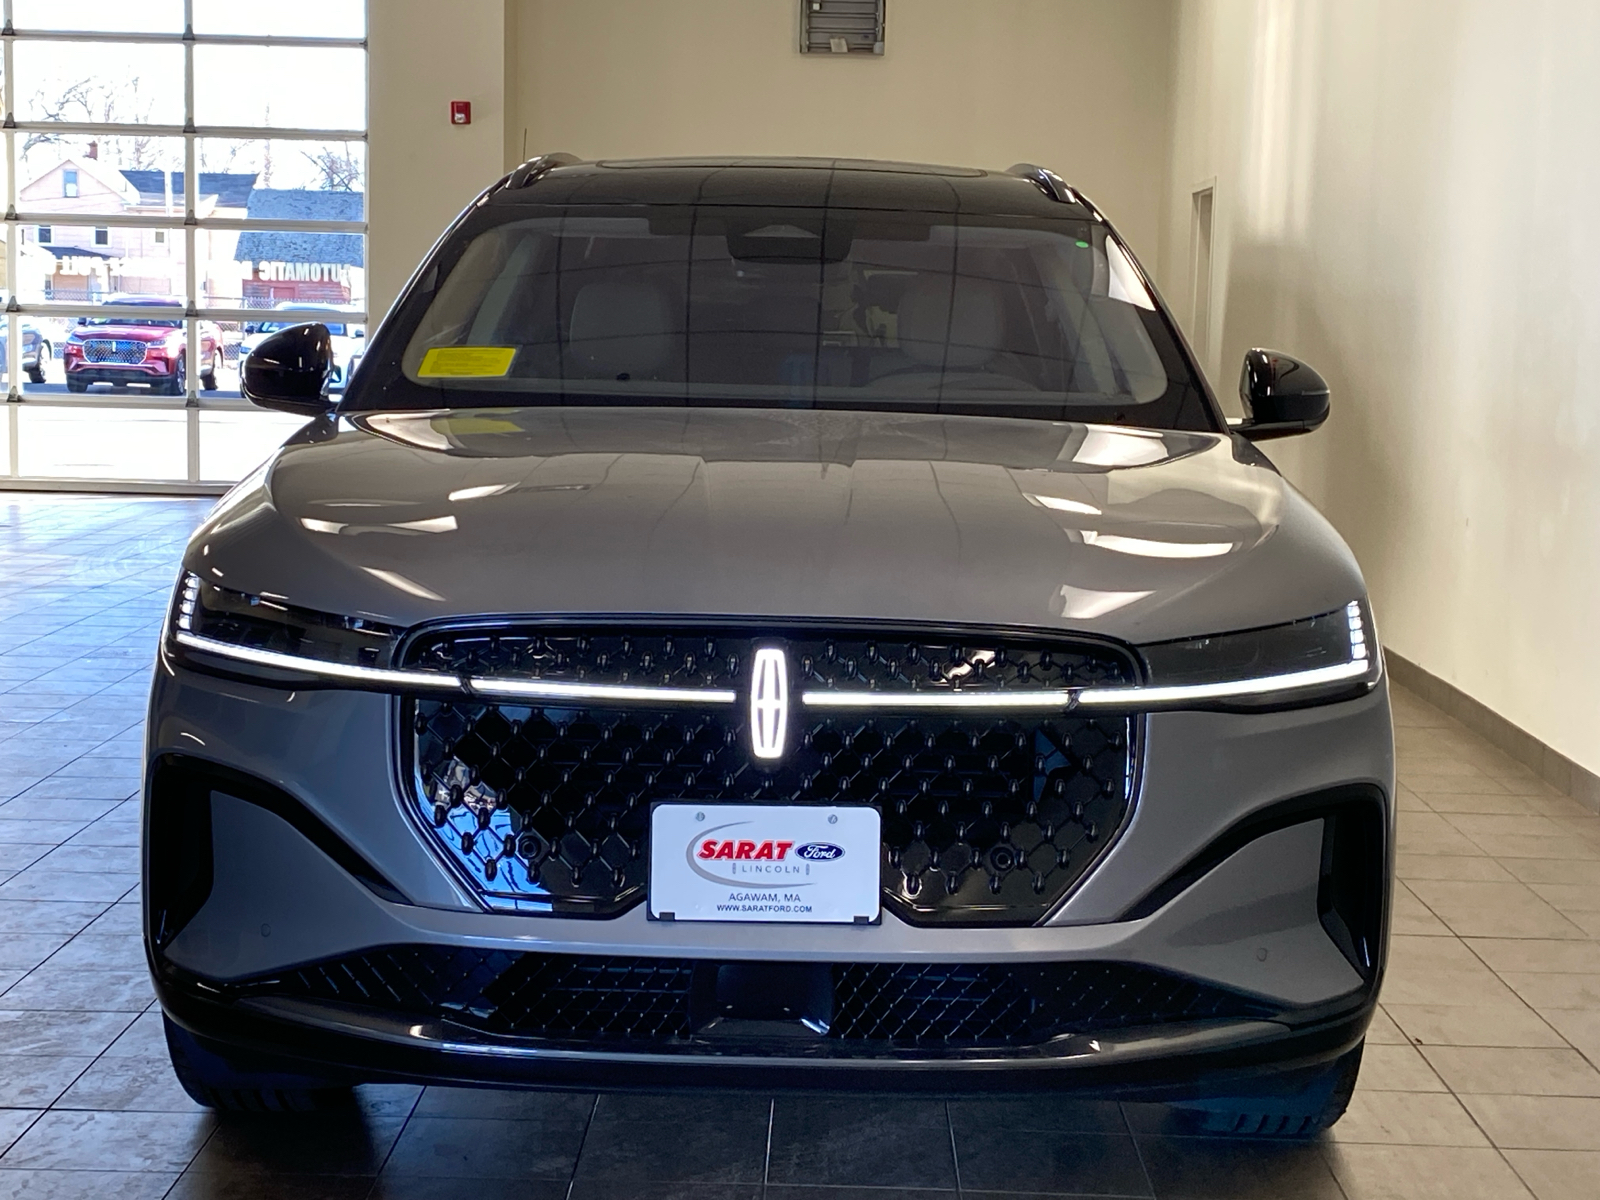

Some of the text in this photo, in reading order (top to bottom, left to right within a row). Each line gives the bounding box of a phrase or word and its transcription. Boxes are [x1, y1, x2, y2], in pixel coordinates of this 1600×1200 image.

[698, 839, 836, 861] SARAT Ford
[741, 864, 800, 874] LINCOLN
[728, 892, 801, 903] AGAWAM, MA
[716, 904, 813, 913] WWW.SARATFORD.COM
